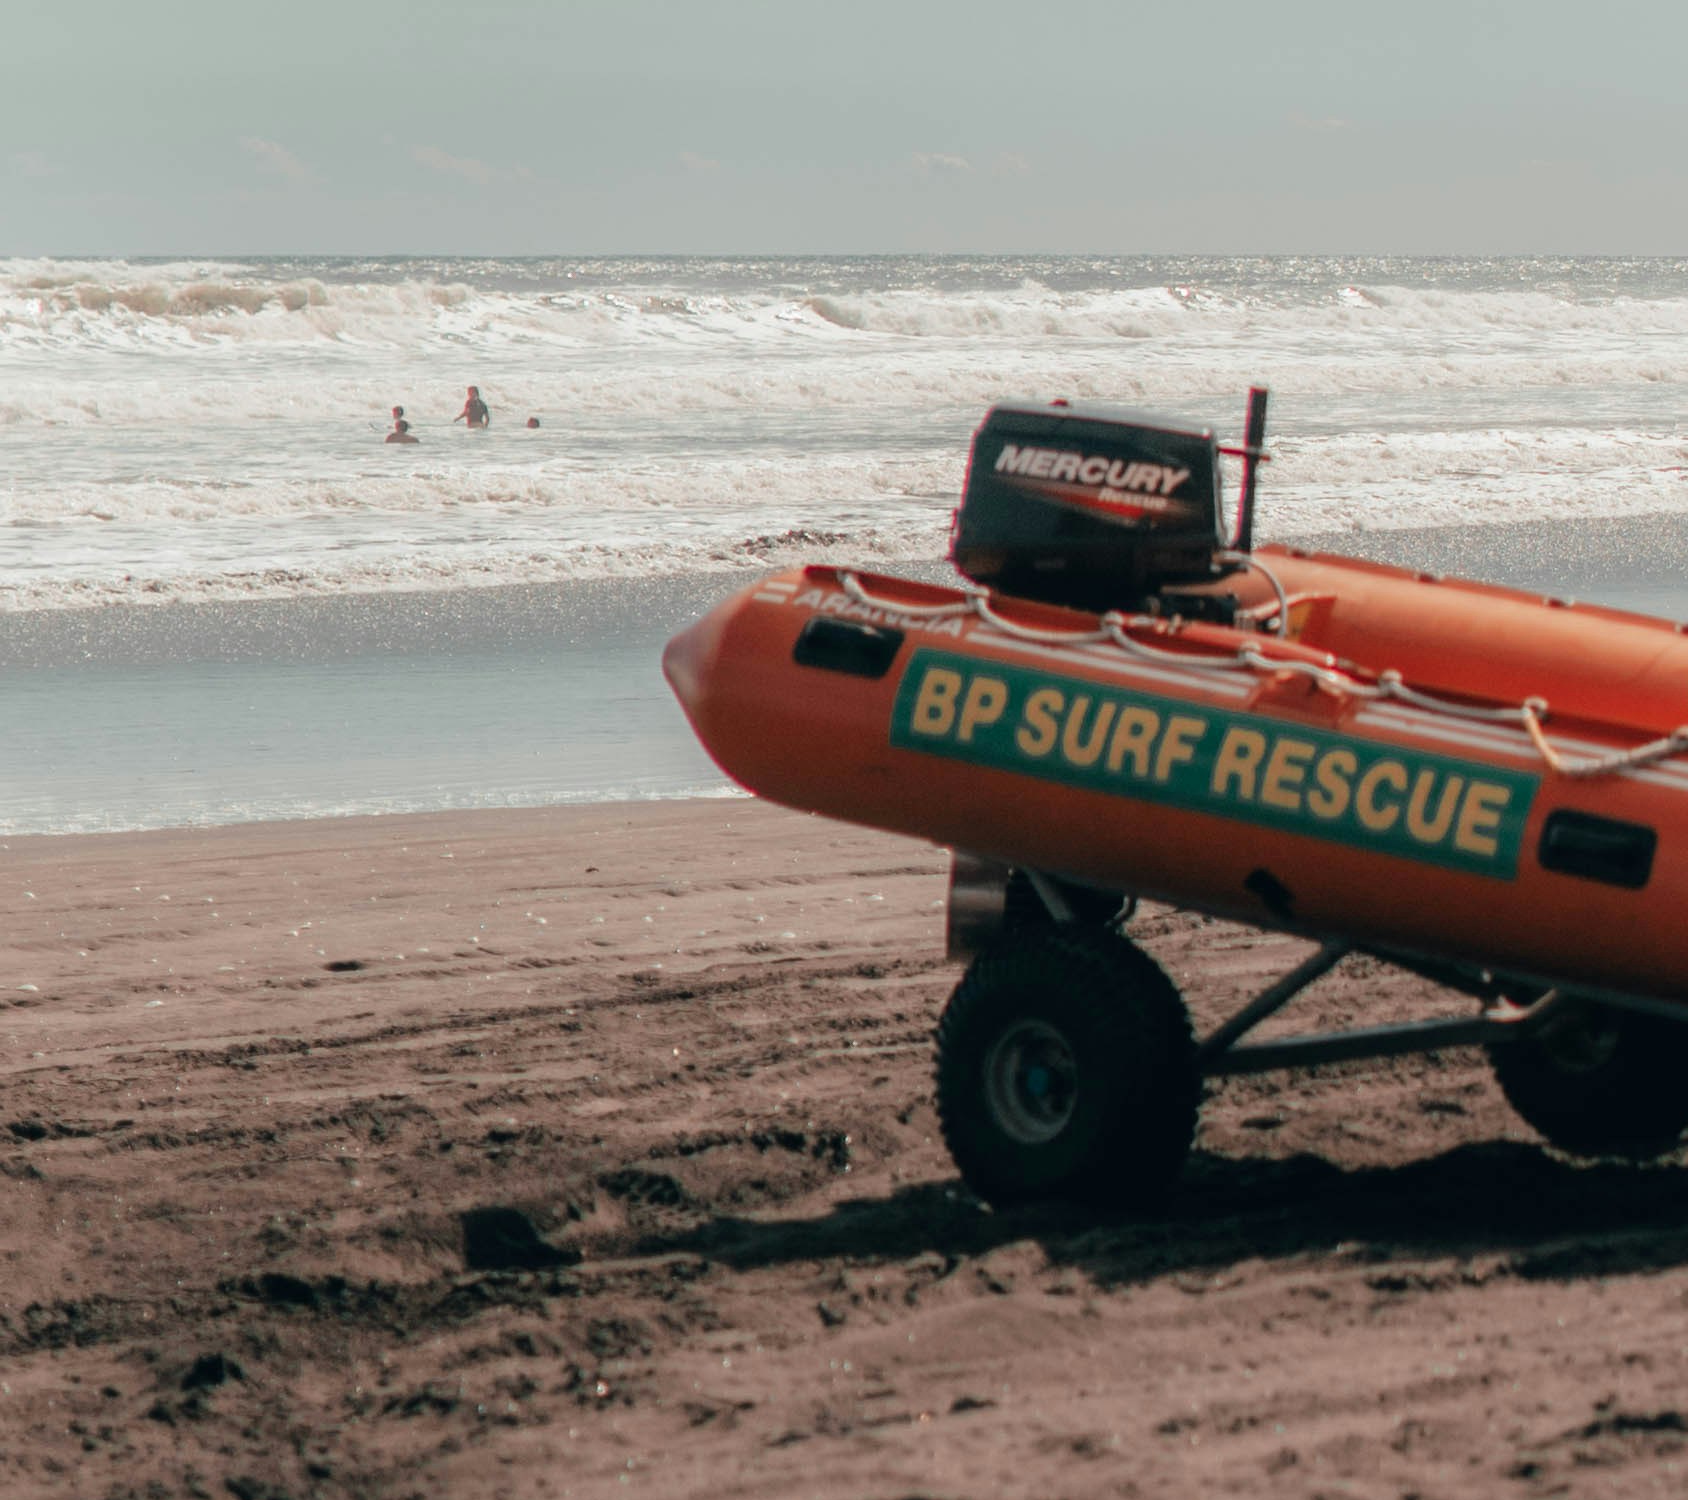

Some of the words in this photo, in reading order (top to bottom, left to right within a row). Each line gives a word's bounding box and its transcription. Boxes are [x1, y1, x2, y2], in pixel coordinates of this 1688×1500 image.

[995, 445, 1190, 494] MERCURY
[911, 667, 1007, 741] BP
[1015, 693, 1206, 784] SURF
[1210, 727, 1510, 856] RESCUE
